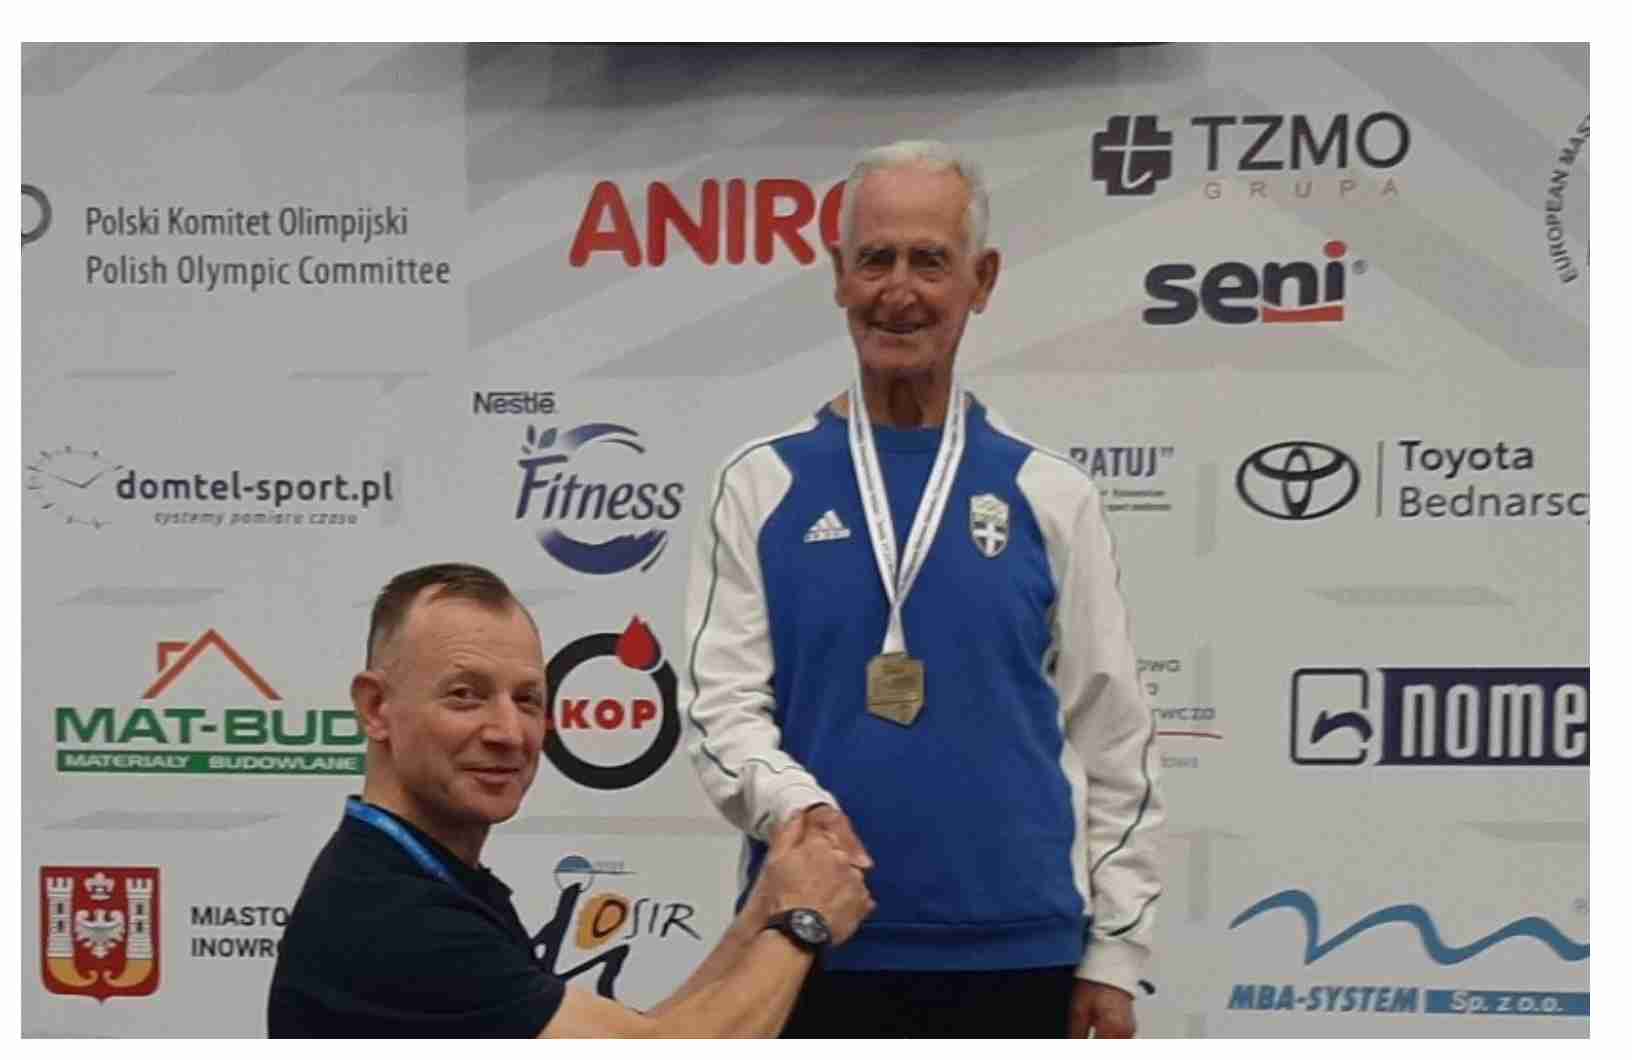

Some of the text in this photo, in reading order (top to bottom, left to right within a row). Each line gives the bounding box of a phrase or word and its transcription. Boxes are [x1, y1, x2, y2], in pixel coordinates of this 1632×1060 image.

[1190, 111, 1411, 172] TZMO
[1203, 178, 1399, 200] GRUPA
[85, 206, 409, 243] Polski Komitet Olimpijski
[85, 254, 451, 293] Polish Olympic Committee
[1142, 240, 1347, 325] seni
[1397, 439, 1535, 480] Toyota
[116, 469, 393, 508] domtel-sport.pl
[514, 453, 685, 521] Fitness
[55, 706, 368, 746] MAT-BUD
[561, 698, 658, 730] KOP
[207, 754, 359, 771] BUDOWLANE
[191, 905, 289, 927] MIASTO
[191, 937, 279, 958] INOWR
[1228, 984, 1419, 1013] MBA-SYSTEM
